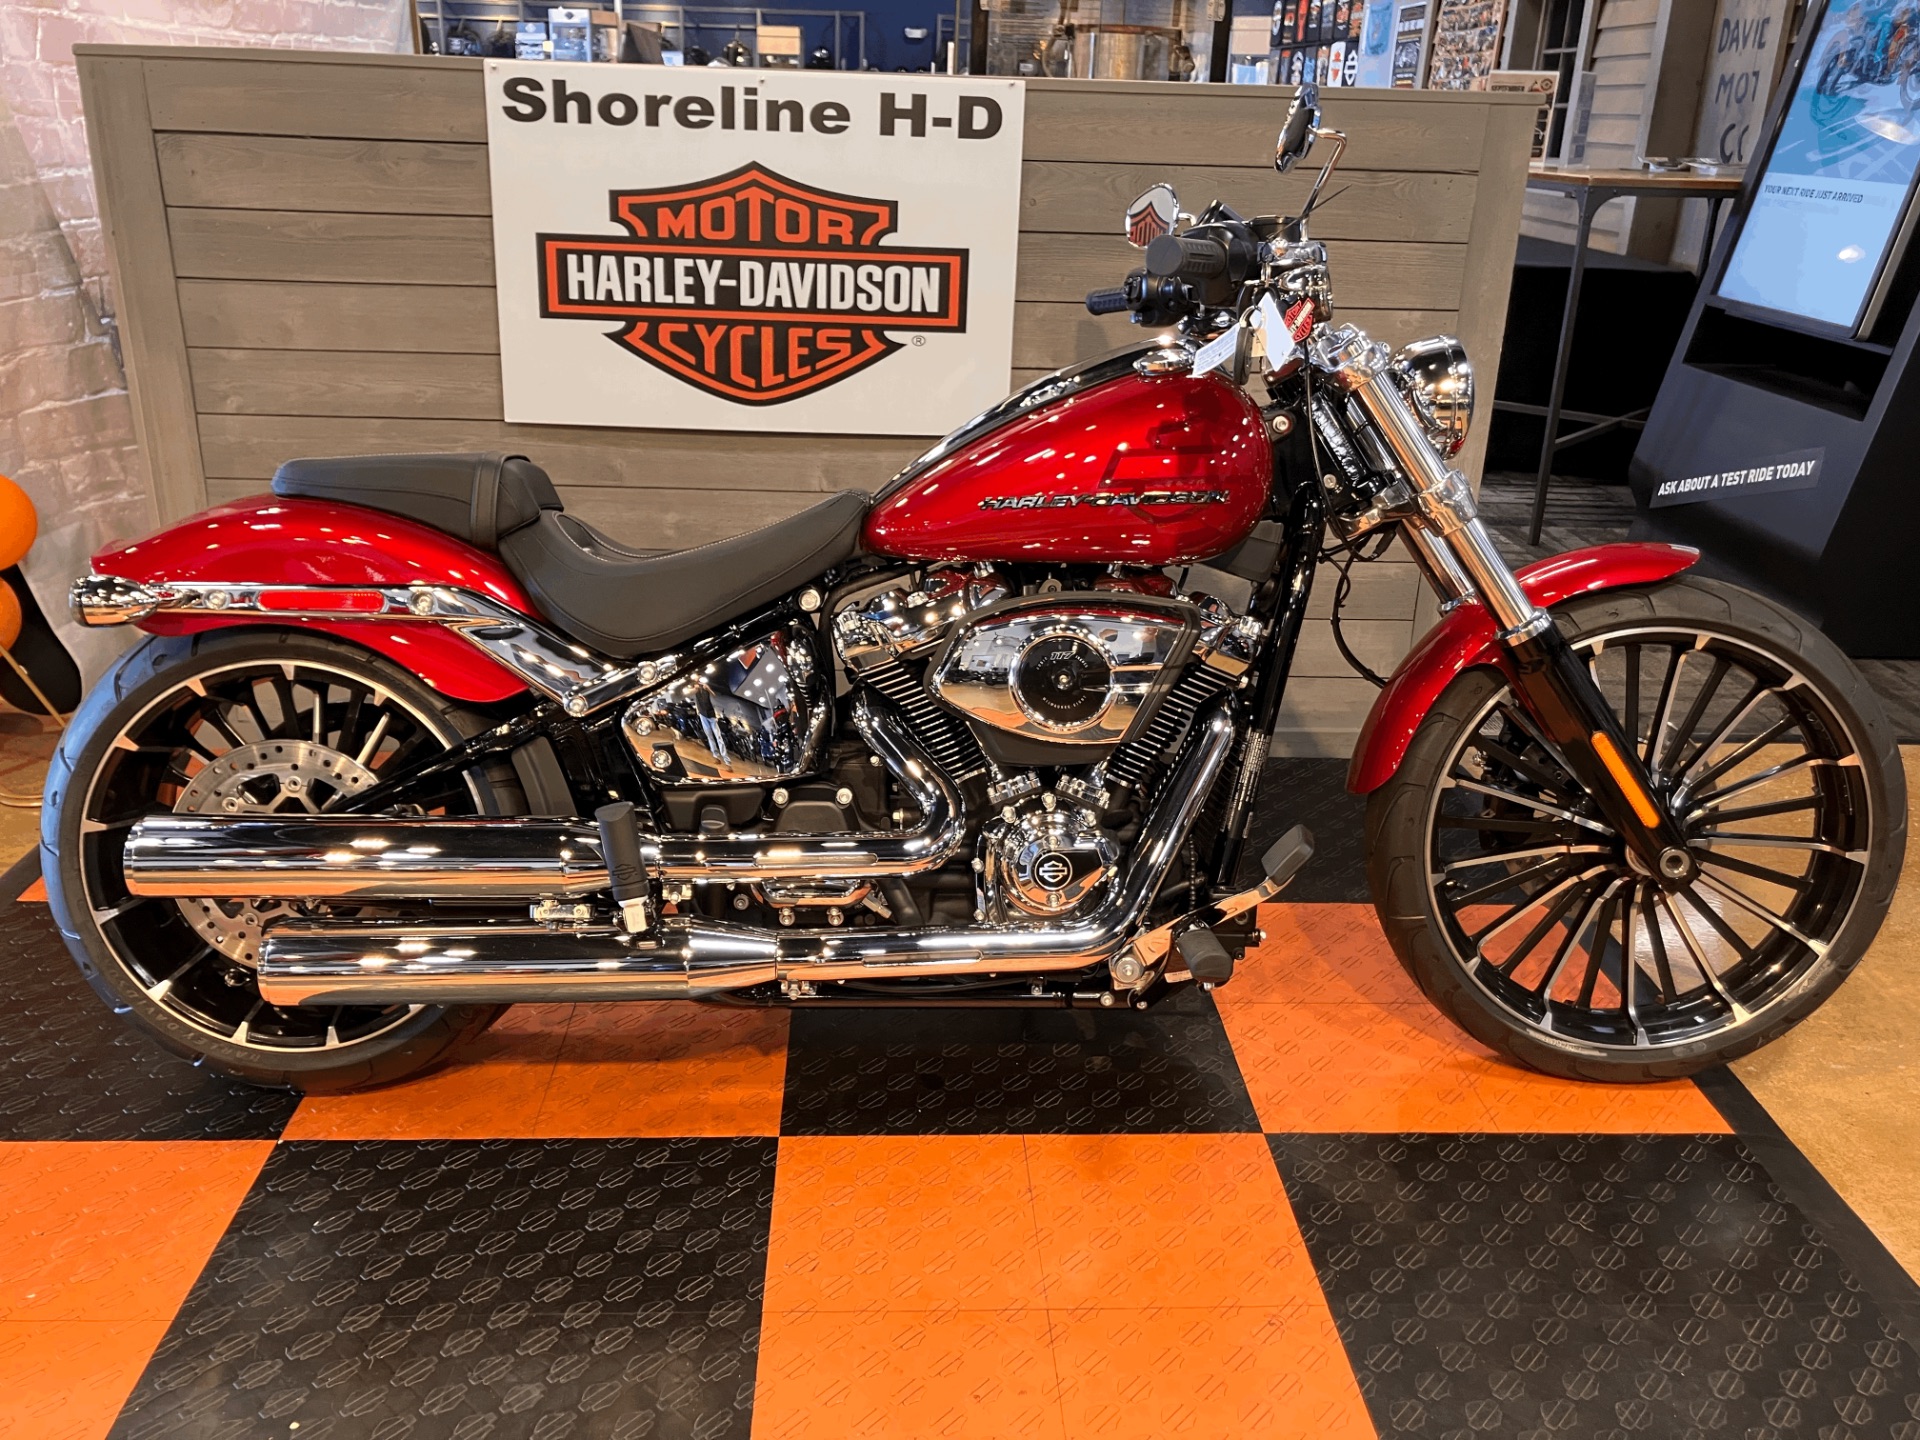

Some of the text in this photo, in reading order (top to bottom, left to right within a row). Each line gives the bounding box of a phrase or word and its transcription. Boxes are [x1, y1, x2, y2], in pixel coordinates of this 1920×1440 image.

[502, 76, 1003, 140] Shoreline H-D
[657, 185, 854, 246] MOTOR
[1765, 184, 1864, 204] YOUR NEXT RIDE JUST ARRIVED
[566, 253, 941, 313] HARLEY-DAVIDSON
[657, 323, 853, 389] CYCLES
[979, 490, 1230, 510] HARLEY-DAVIDSON
[1658, 460, 1816, 496] ASK ABOUT A TEST RIDE TODAY
